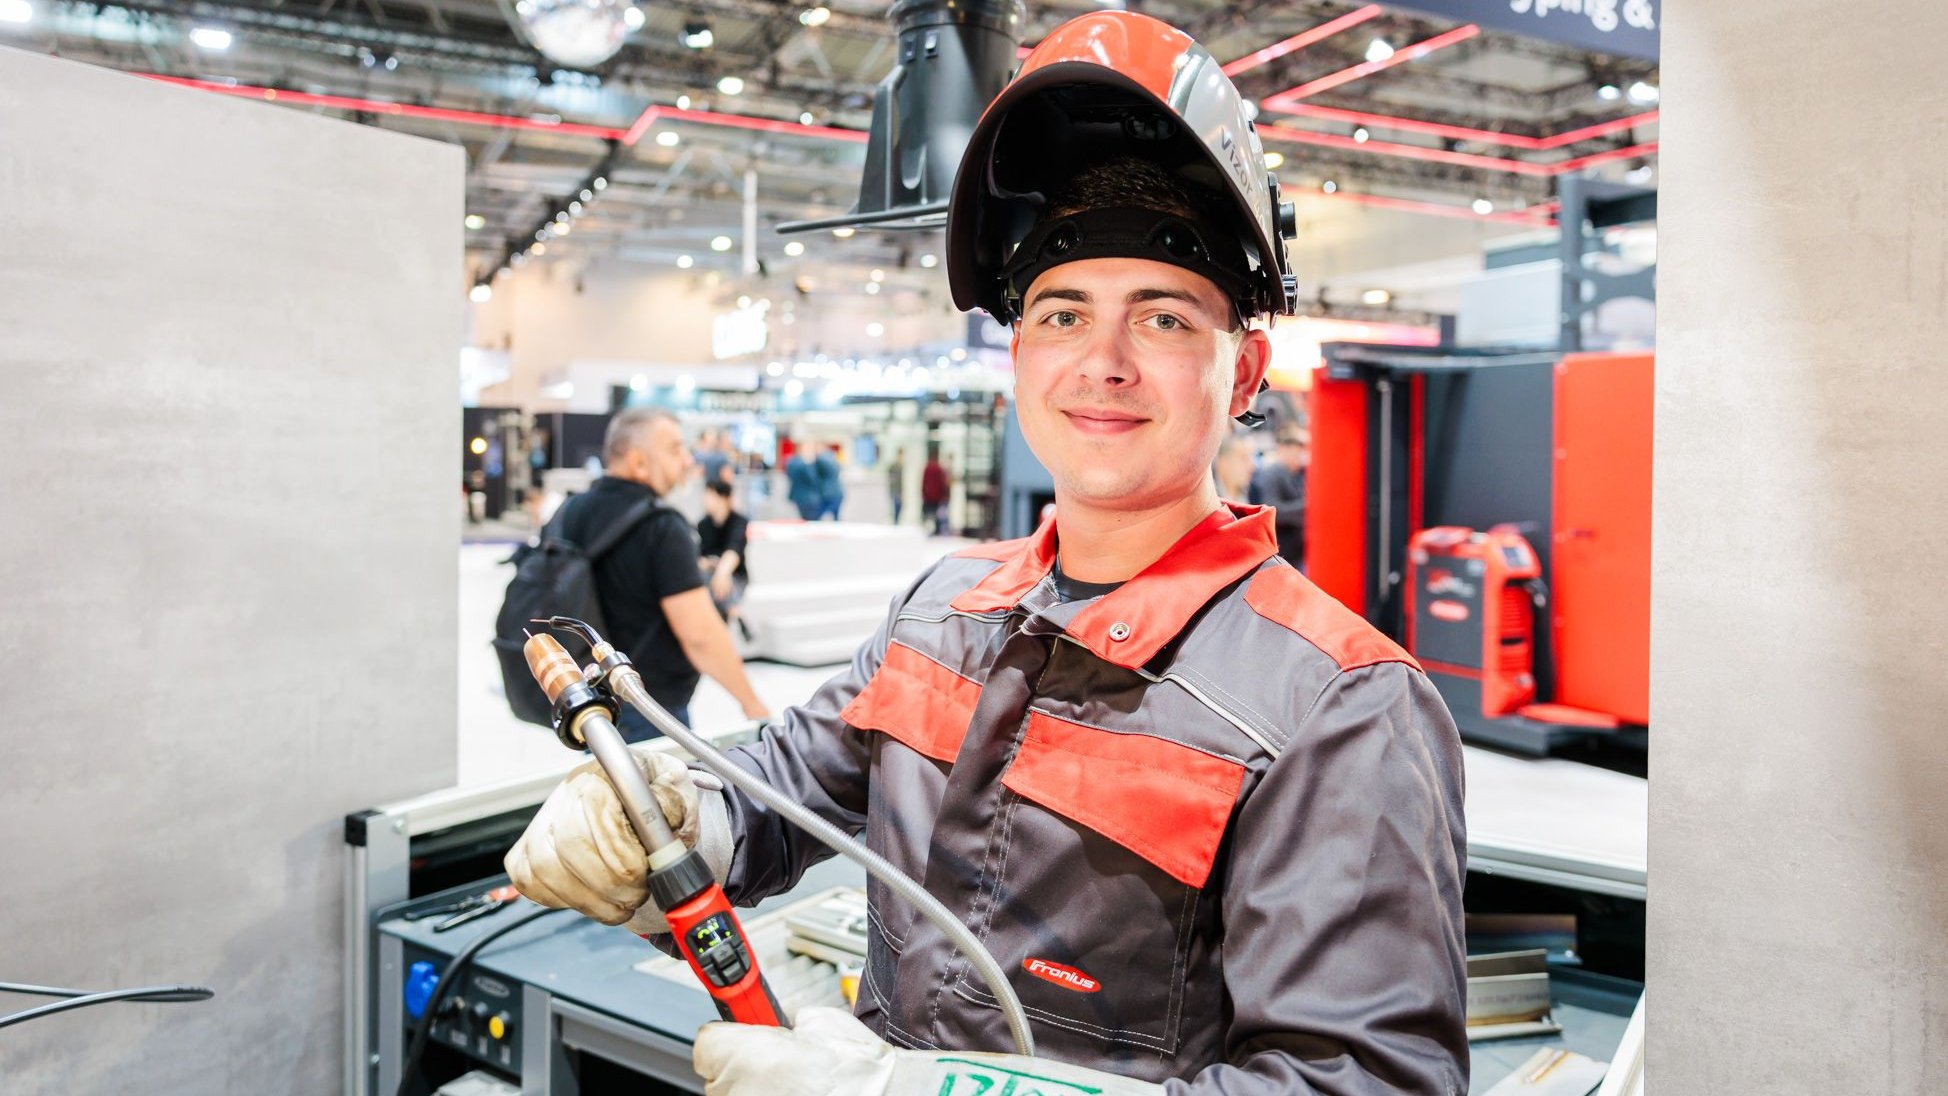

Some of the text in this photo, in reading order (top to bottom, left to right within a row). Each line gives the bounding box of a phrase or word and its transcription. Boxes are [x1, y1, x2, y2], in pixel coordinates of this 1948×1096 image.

[1623, 0, 1655, 30] &
[1220, 127, 1253, 195] Vizor
[1029, 959, 1096, 989] Fronius
